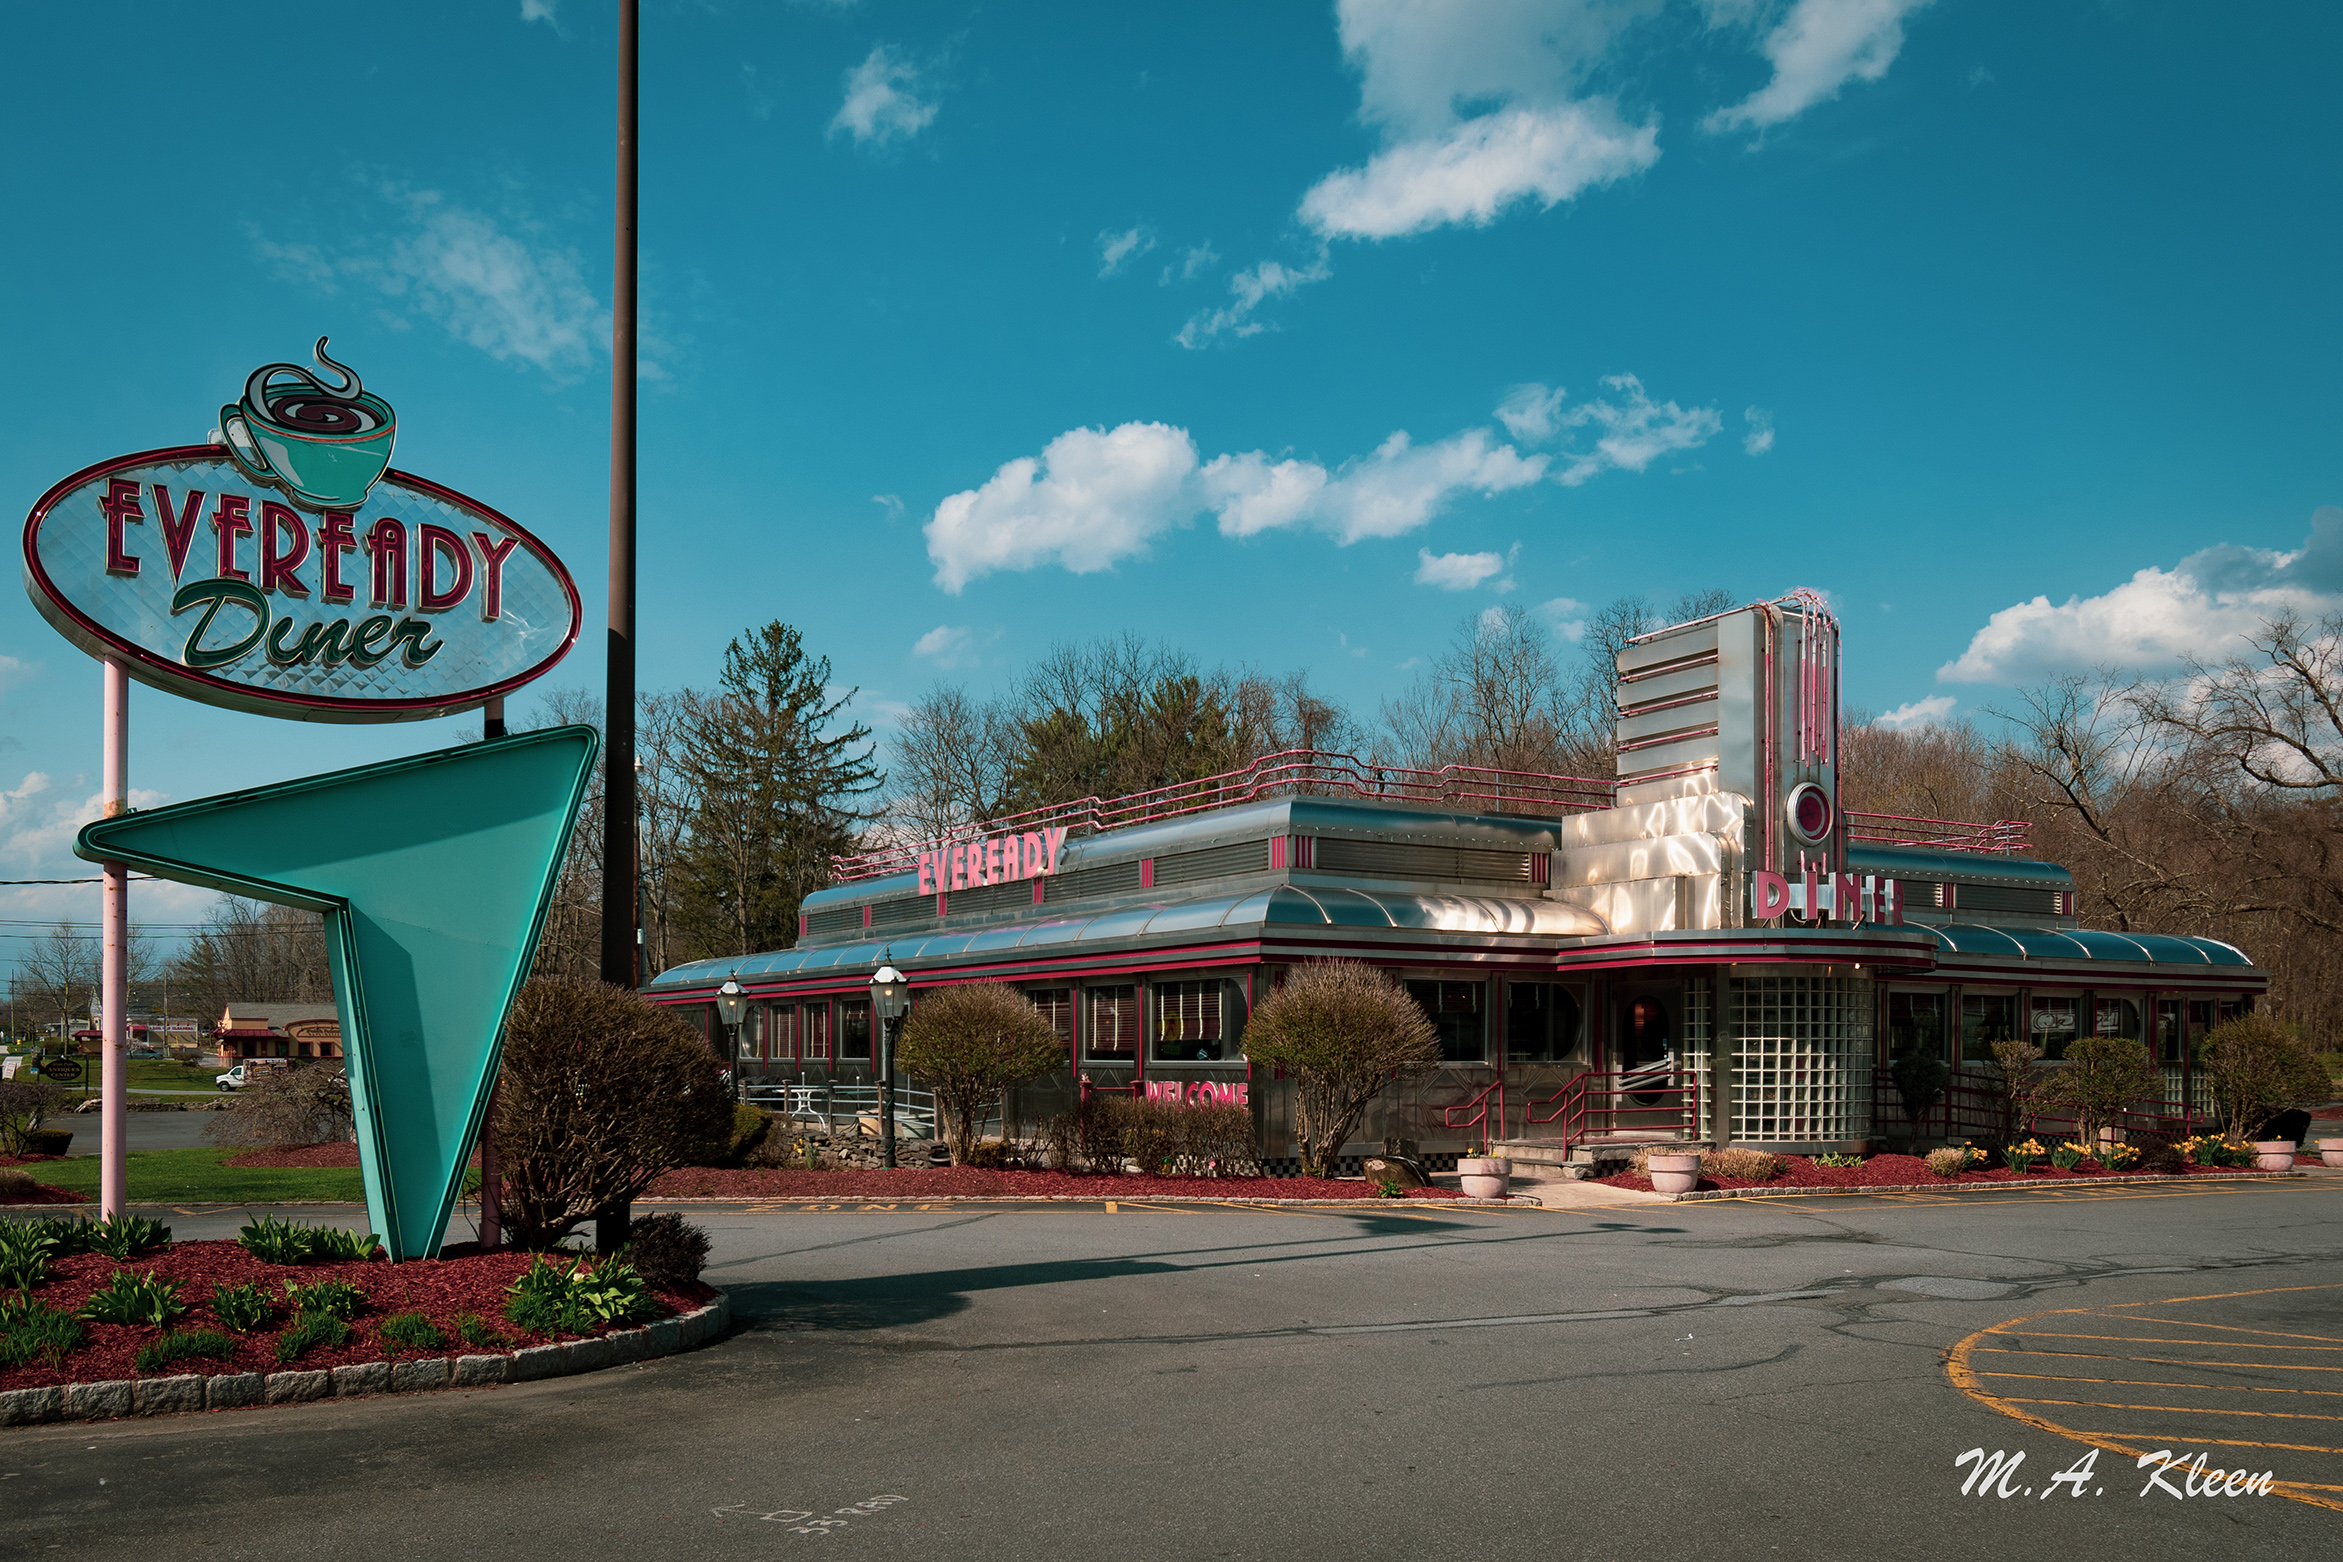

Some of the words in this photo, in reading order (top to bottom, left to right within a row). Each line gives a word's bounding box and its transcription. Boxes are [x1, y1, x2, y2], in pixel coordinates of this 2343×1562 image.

[99, 477, 520, 623] EVEREADY
[170, 578, 444, 669] Diner
[918, 827, 1067, 896] EVEREADY
[1752, 870, 1904, 926] DINER
[1146, 1081, 1248, 1114] WELCOME
[745, 1203, 955, 1211] ZONE
